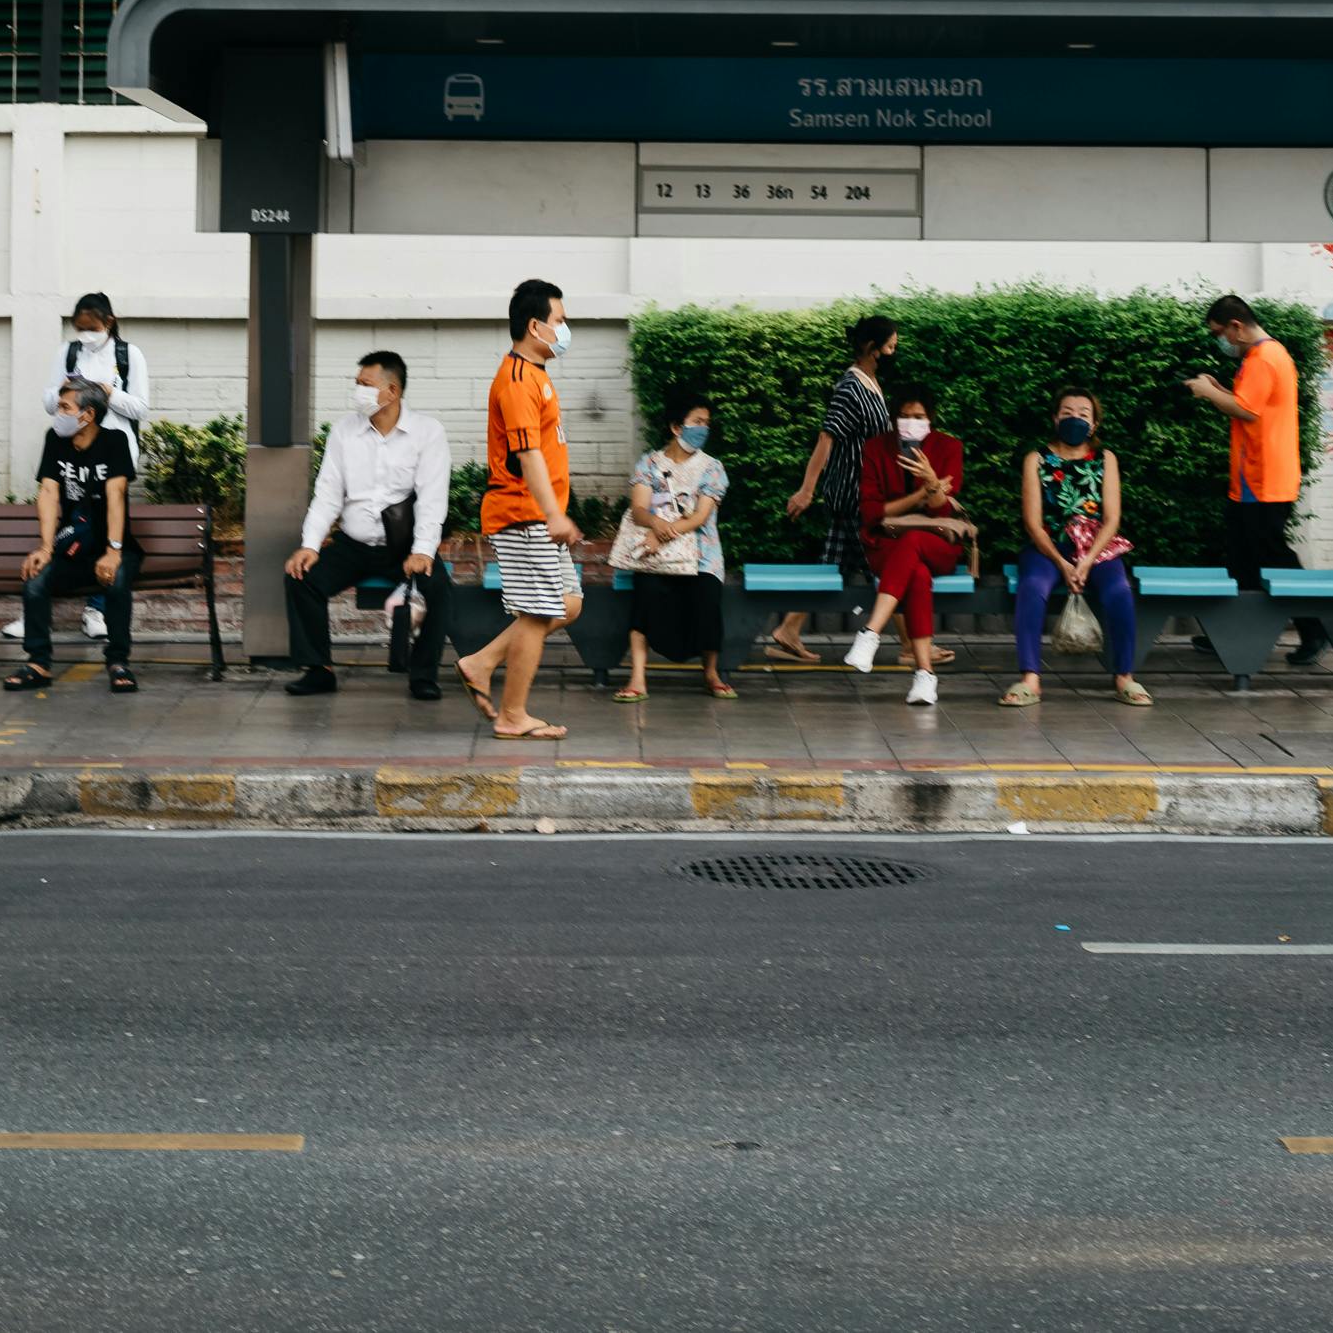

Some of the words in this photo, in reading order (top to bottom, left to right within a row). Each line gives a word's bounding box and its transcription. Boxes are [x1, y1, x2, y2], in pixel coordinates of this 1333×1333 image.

[798, 77, 983, 97] รร.สามเสนนอก
[789, 108, 870, 128] Samsen
[876, 108, 917, 128] Nok
[923, 108, 992, 128] School
[656, 183, 673, 199] 12
[695, 183, 712, 199] 13
[733, 184, 751, 200] 36
[810, 185, 828, 200] 54
[844, 185, 872, 201] 204
